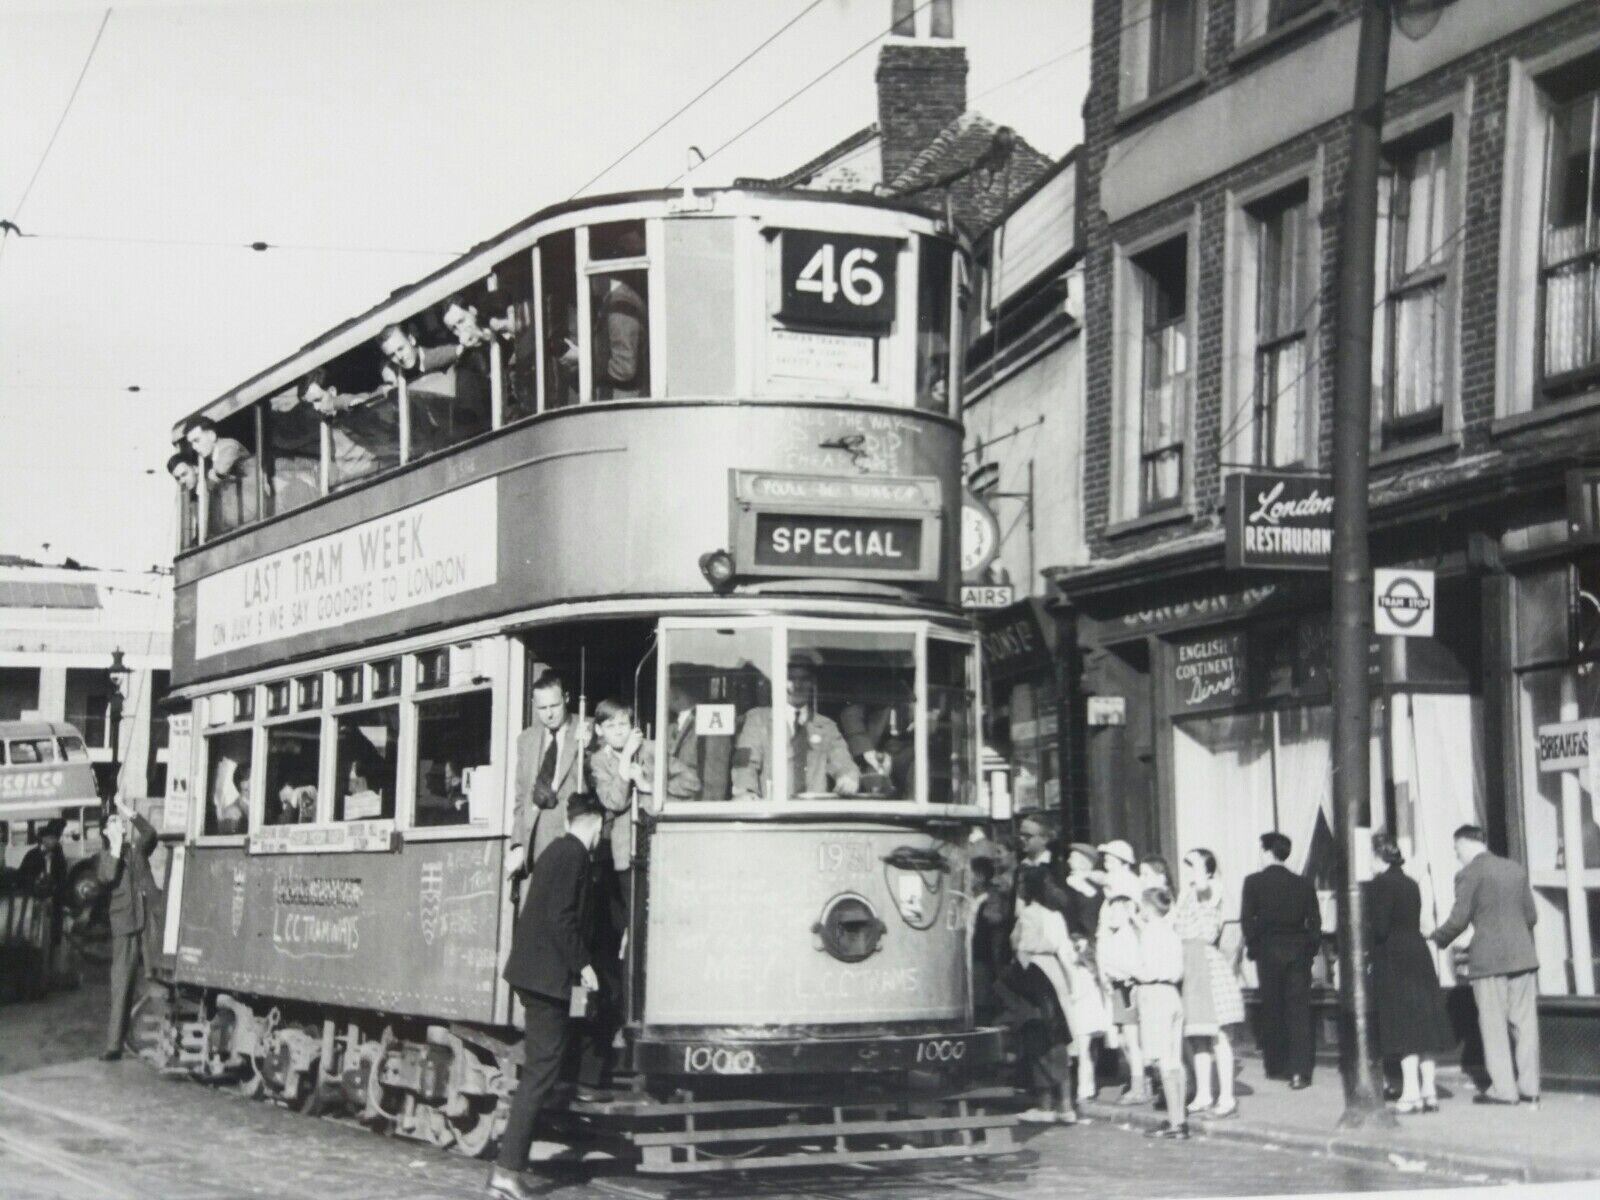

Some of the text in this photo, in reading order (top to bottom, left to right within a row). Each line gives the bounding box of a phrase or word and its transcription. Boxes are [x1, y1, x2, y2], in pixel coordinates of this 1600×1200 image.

[795, 244, 884, 306] 46
[1249, 481, 1334, 524] London
[772, 528, 903, 557] SPECIAL
[1245, 526, 1333, 556] RESTAURAN
[243, 513, 424, 608] LAST TRAM WEEK
[212, 621, 227, 647] ON
[269, 605, 285, 632] WE
[291, 600, 309, 628] SAY
[317, 581, 373, 621] GOODBYE
[381, 576, 397, 603] TO
[407, 552, 467, 599] LONDON
[1381, 597, 1429, 609] TRAM STOP
[709, 712, 723, 729] A
[683, 1045, 756, 1075] 1000
[914, 1041, 966, 1062] 1000
